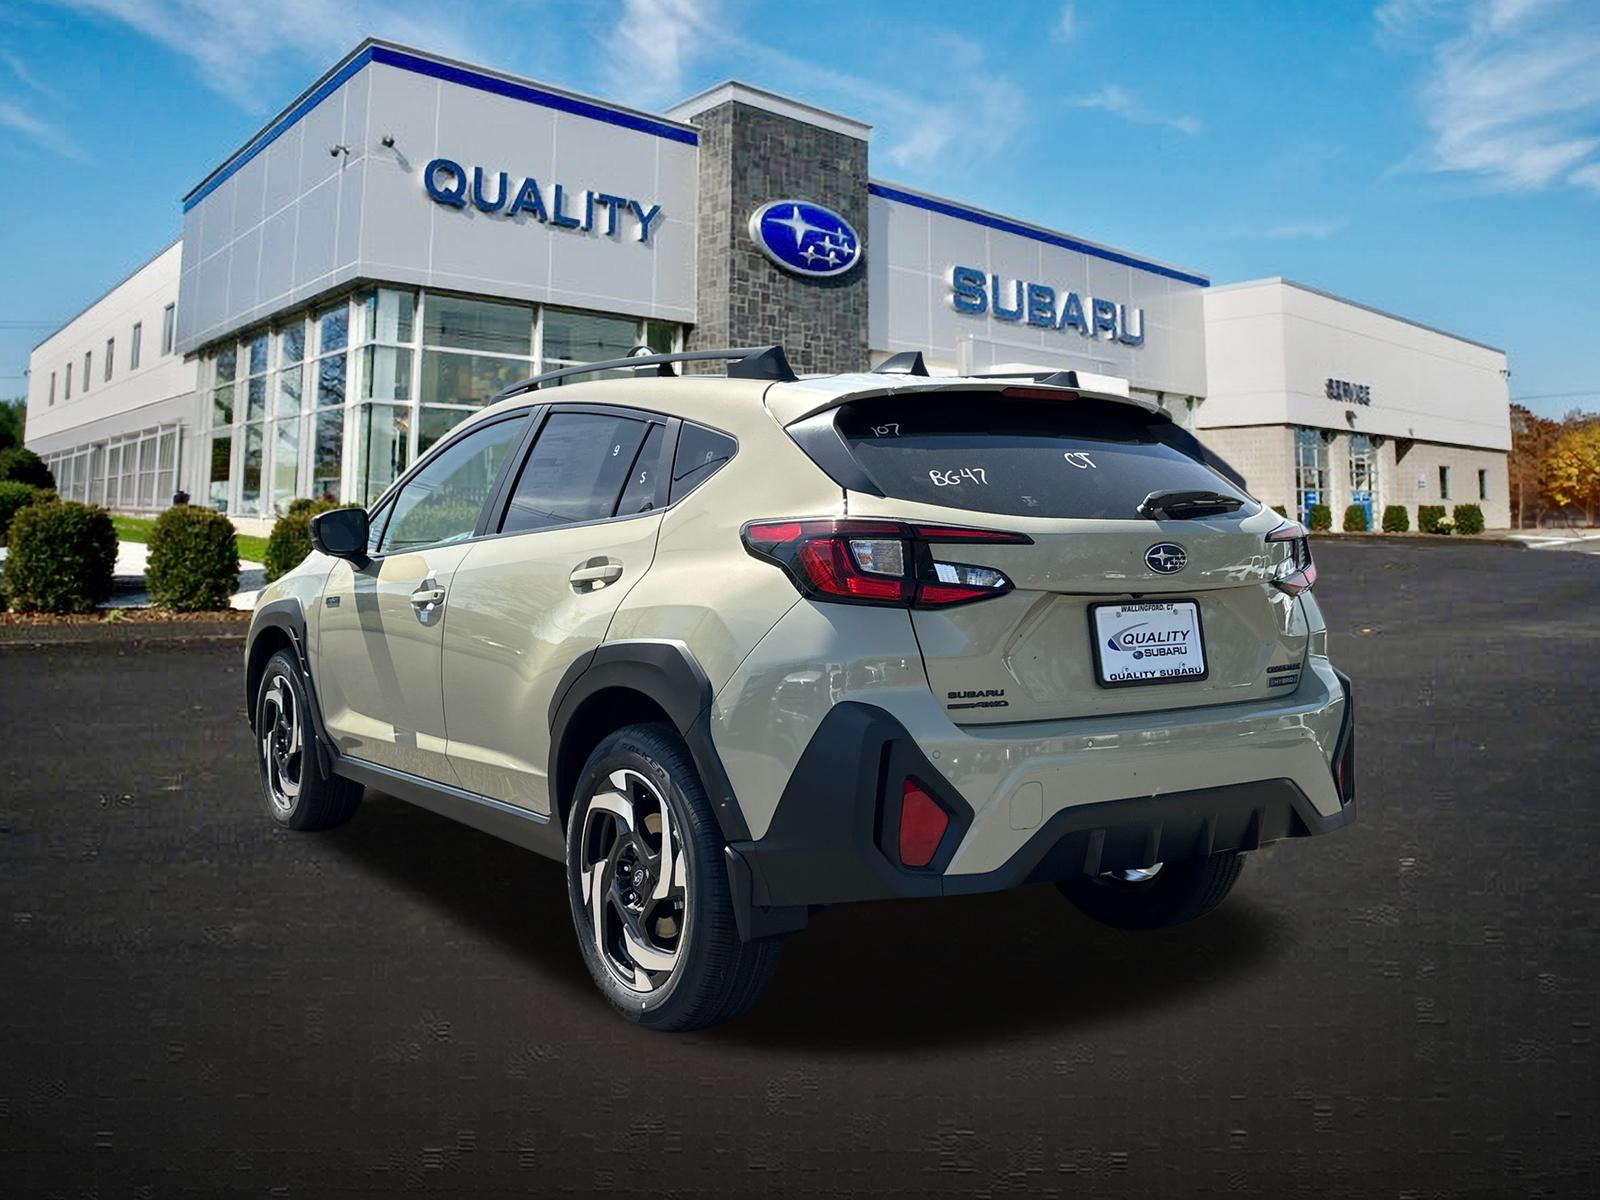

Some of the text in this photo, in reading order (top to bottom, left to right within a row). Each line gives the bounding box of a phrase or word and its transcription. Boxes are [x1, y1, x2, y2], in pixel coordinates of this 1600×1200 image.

[424, 158, 661, 243] QUALITY
[950, 265, 1145, 347] SUBARU
[929, 468, 989, 486] BG47
[1166, 603, 1174, 611] CT
[1123, 630, 1190, 645] QUALITY
[1144, 646, 1188, 657] SUBARU
[1110, 667, 1202, 681] QUALITY SUBARU
[947, 689, 1004, 699] SUBARU
